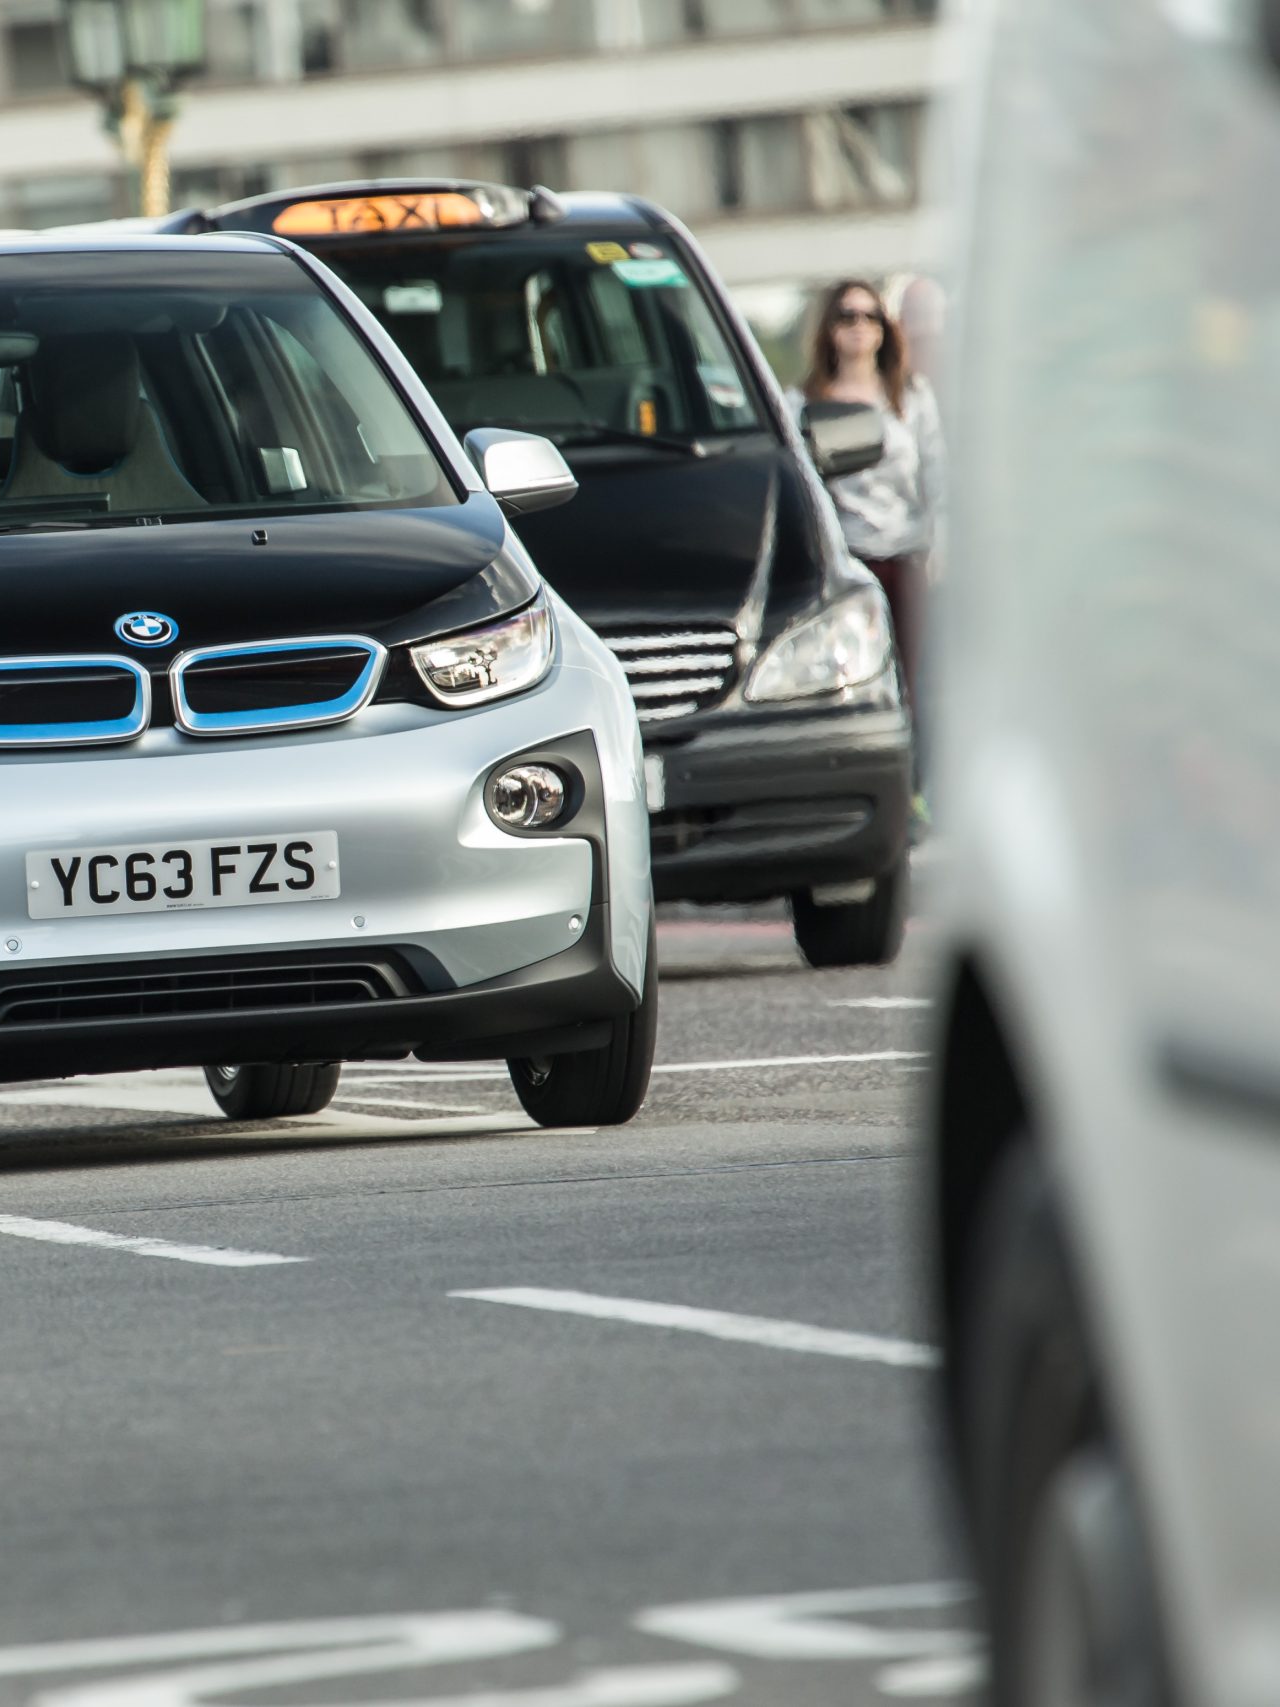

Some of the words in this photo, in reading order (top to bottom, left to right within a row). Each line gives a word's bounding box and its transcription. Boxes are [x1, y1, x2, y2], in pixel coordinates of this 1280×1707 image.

[319, 196, 441, 233] TAXI
[50, 849, 194, 907] YC63
[210, 841, 316, 897] FZS
